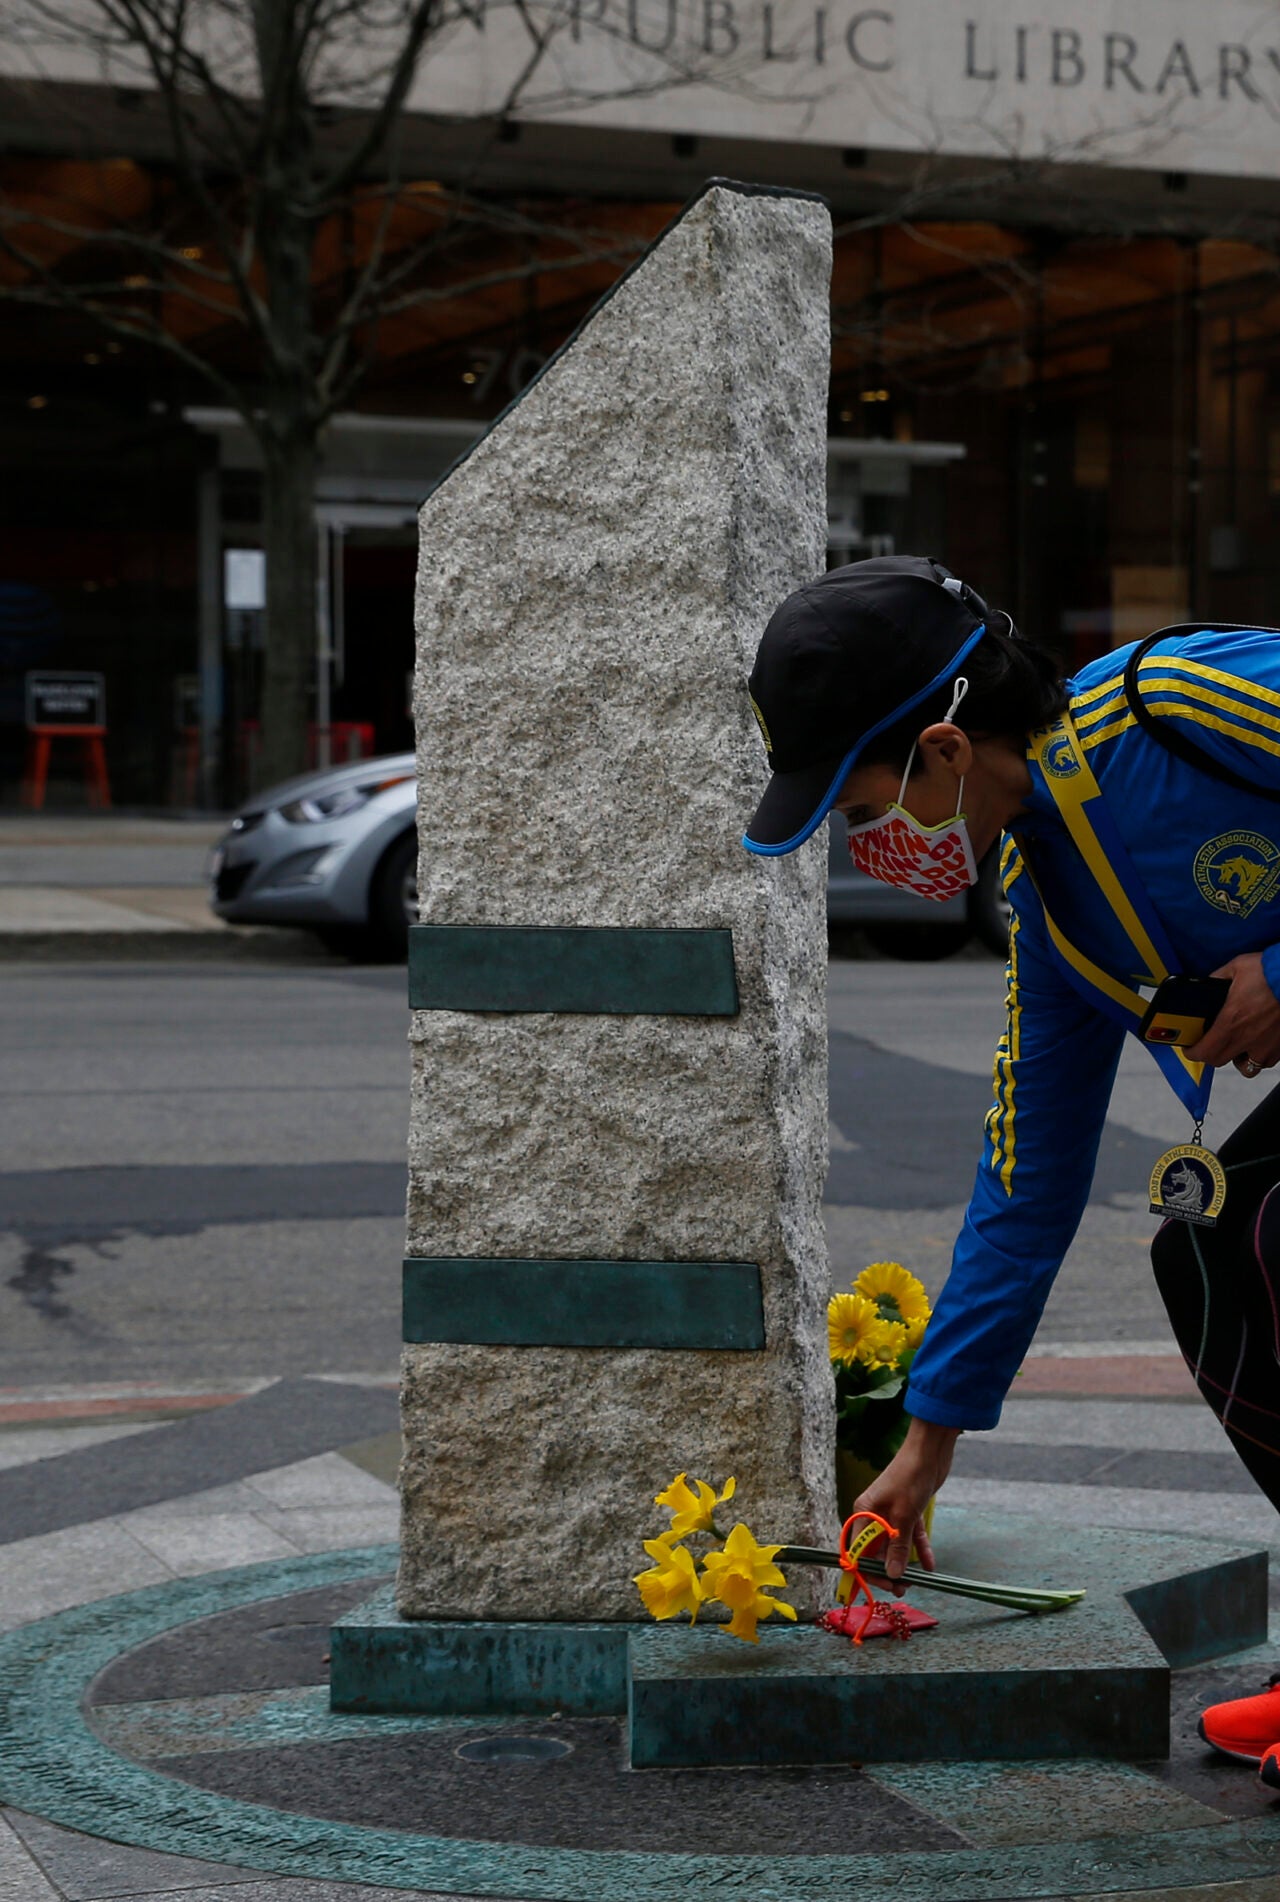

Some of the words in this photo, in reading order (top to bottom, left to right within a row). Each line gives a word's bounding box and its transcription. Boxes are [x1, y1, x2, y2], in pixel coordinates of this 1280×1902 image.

[570, 0, 893, 71] PUBLIC
[1215, 833, 1275, 858] ASSOCIATION
[1151, 1163, 1165, 1198] BOSTON
[1164, 1147, 1203, 1165] ATHLETIC
[1203, 1153, 1225, 1212] ASSOCIATION
[780, 1873, 870, 1889] we
